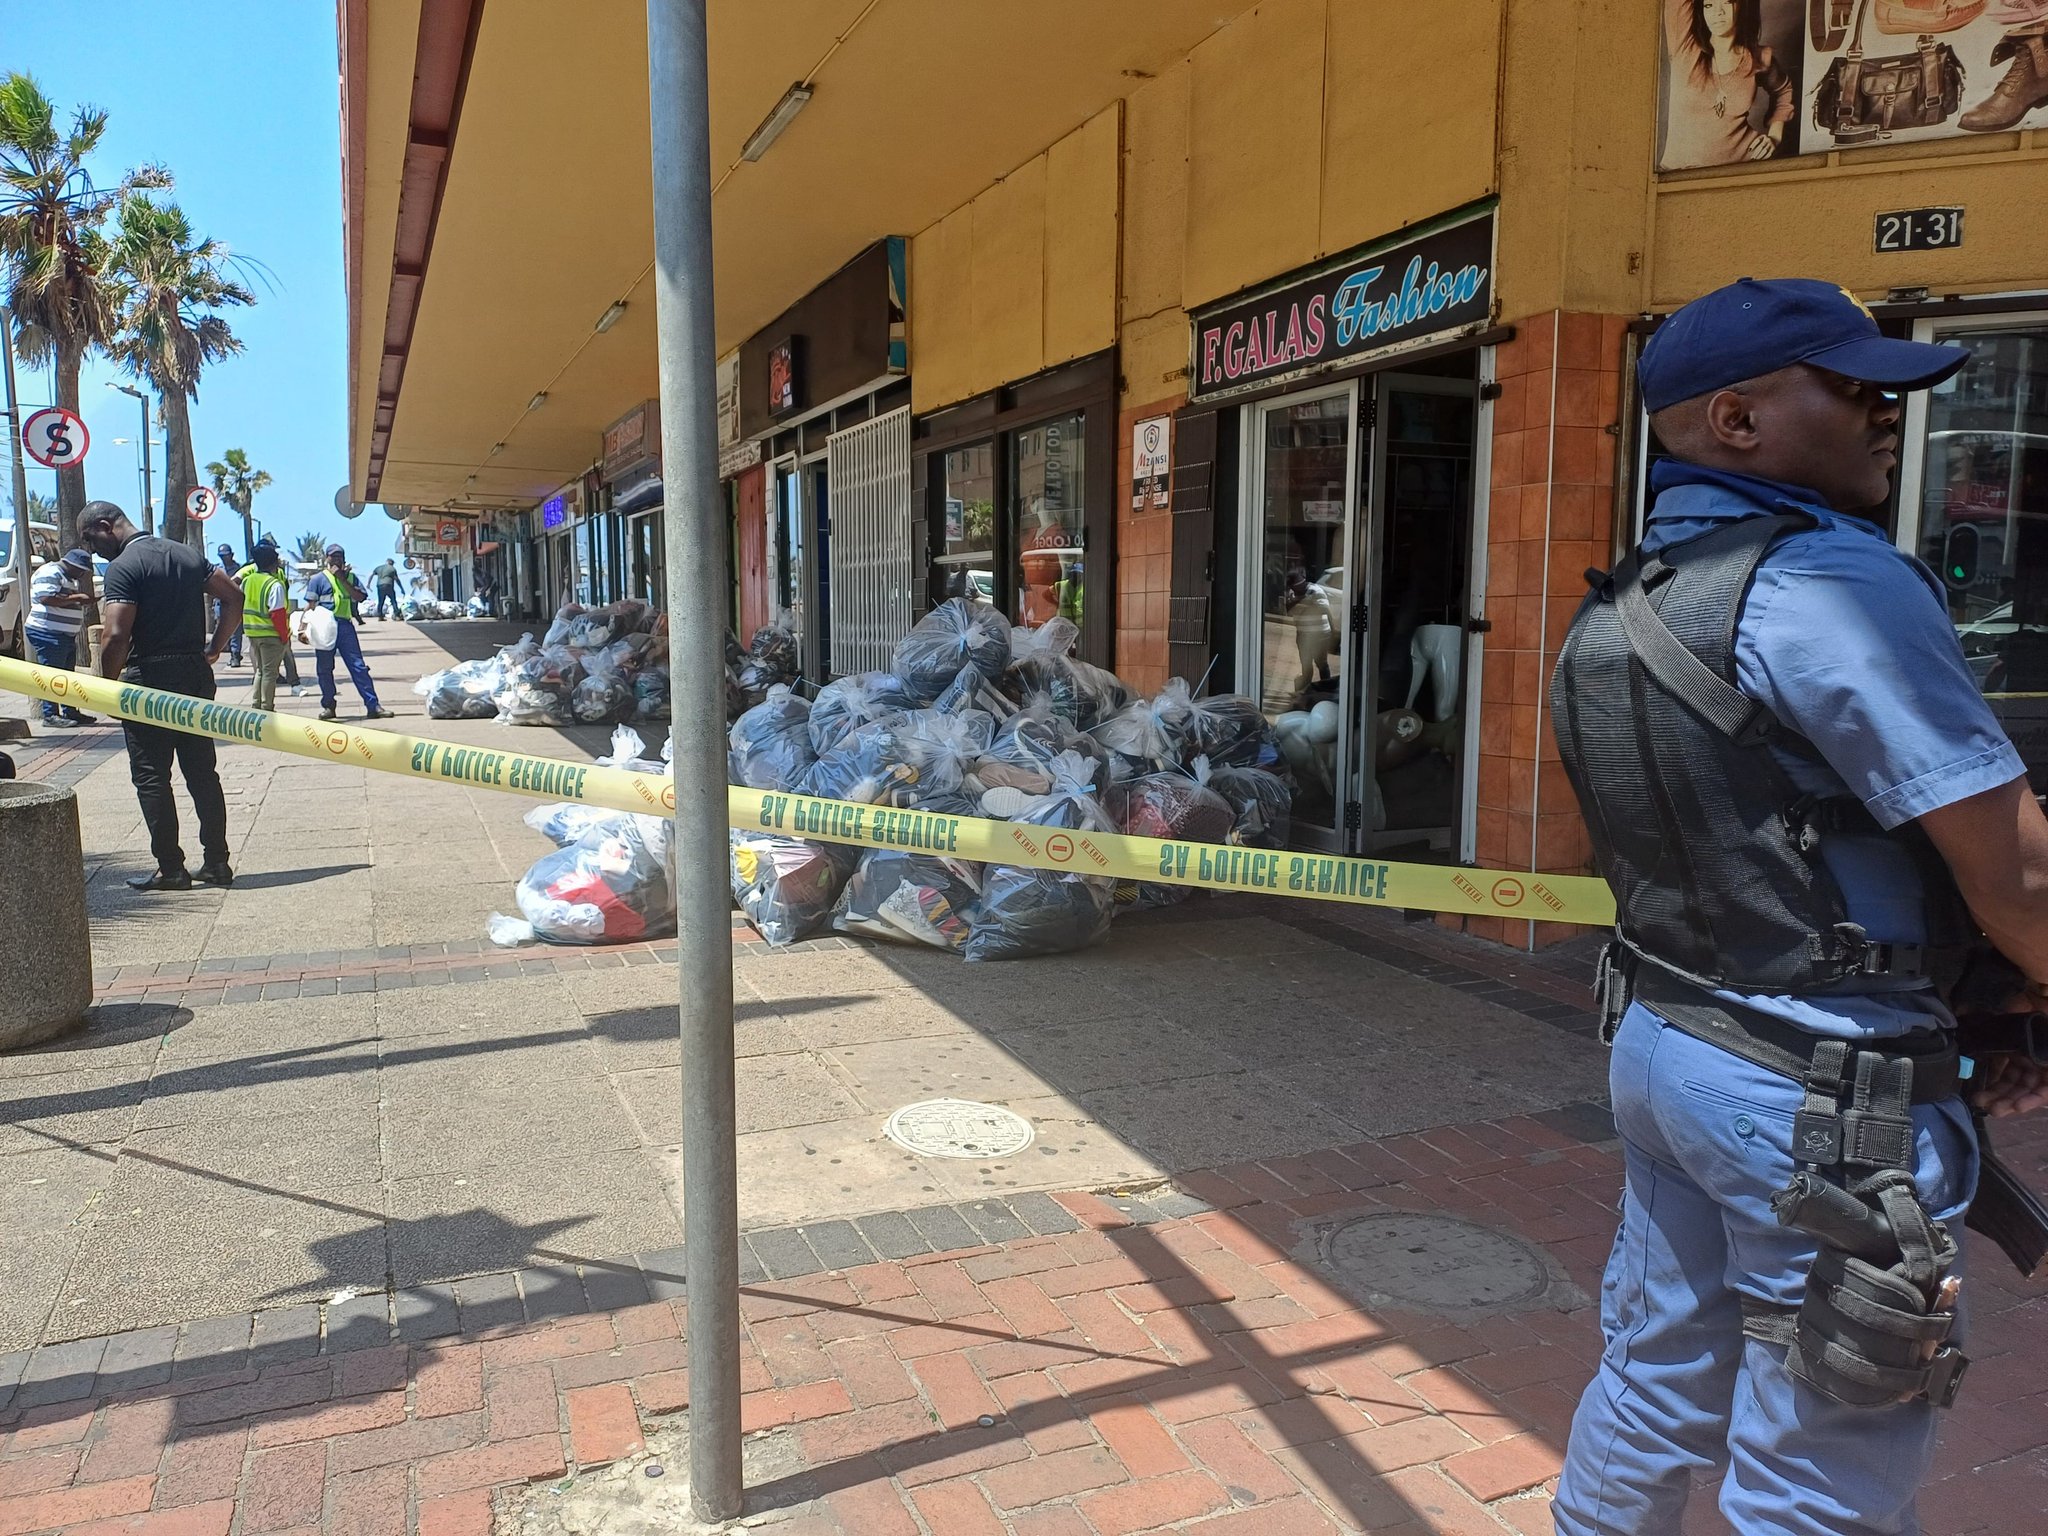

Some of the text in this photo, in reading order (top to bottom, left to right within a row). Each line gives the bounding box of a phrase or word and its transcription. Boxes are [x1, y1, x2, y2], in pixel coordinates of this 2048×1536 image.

[1880, 212, 1958, 249] 21-31
[1202, 254, 1487, 385] F.GALAS Fashion
